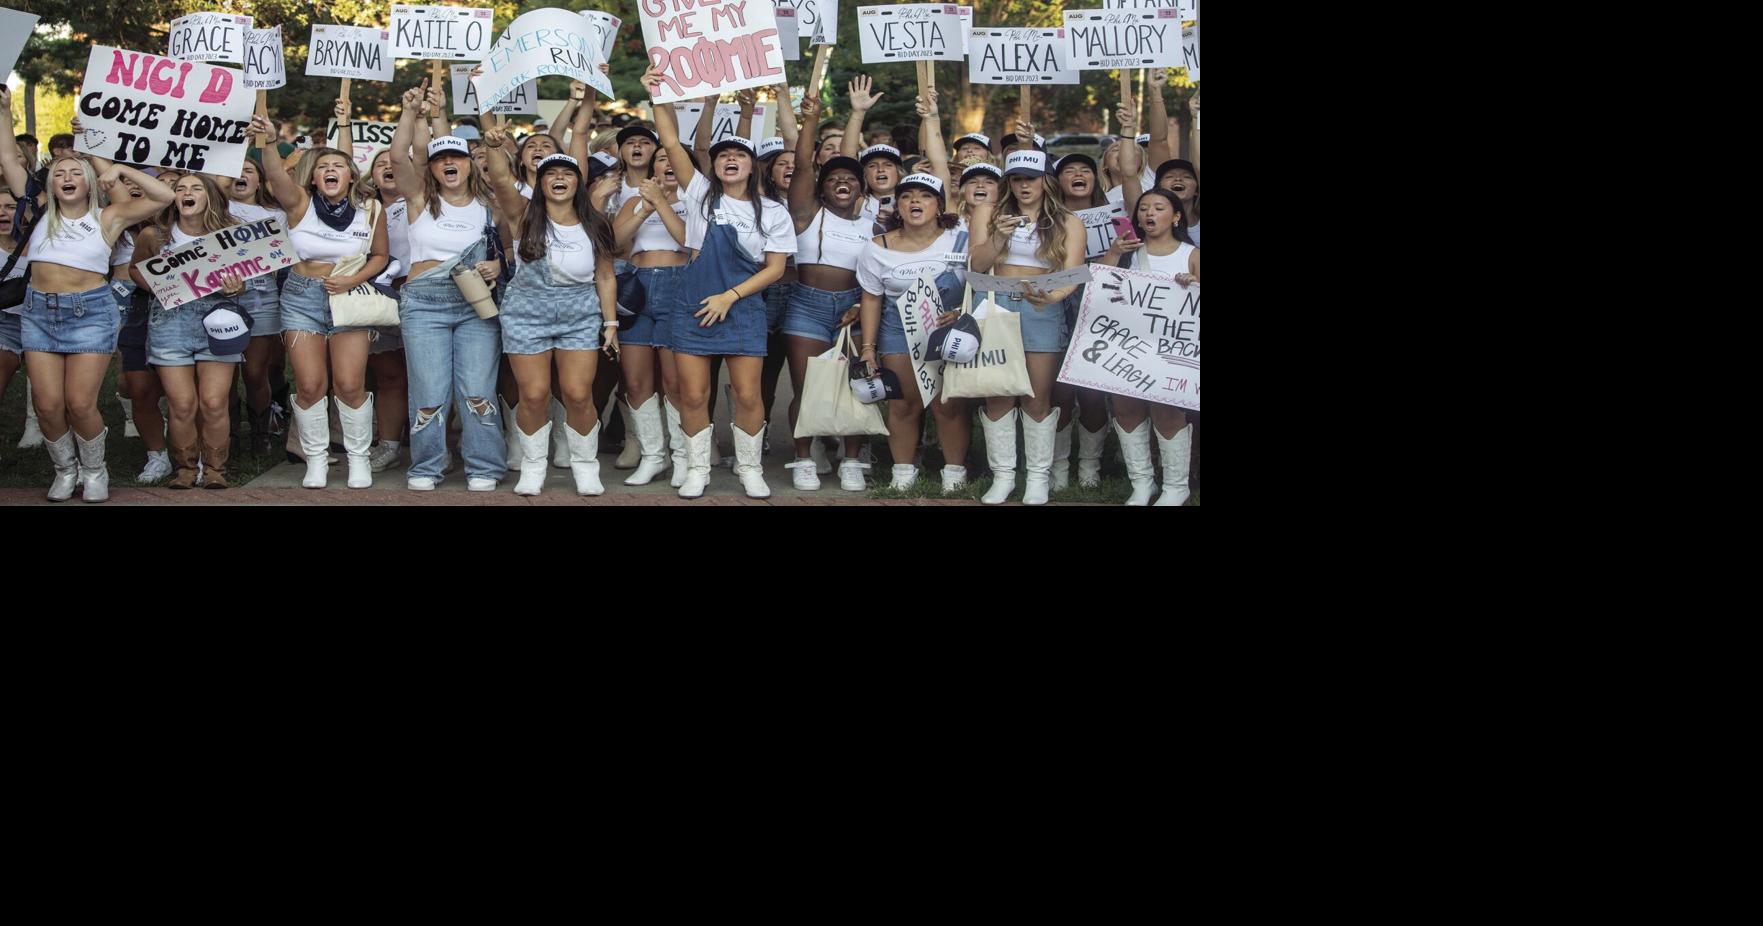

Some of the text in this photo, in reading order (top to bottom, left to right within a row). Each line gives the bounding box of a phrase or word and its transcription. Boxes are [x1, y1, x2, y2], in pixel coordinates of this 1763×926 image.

[396, 18, 459, 50] KATIE
[658, 1, 747, 42] ME MY
[869, 21, 946, 51] VESTA
[172, 26, 234, 56] GRACE
[314, 39, 382, 71] BRYNNA
[490, 28, 595, 72] EMERSON
[1071, 24, 1167, 58] MALLORY
[105, 50, 193, 99] NICI
[549, 47, 594, 76] RUN
[1111, 59, 1123, 67] DAY
[80, 92, 250, 144] COME HOME
[114, 131, 210, 171] TO ME
[432, 140, 445, 148] PHI
[761, 141, 774, 149] PHI
[1009, 156, 1039, 164] PHI MU
[921, 176, 936, 185] MU
[181, 255, 271, 299] Karinne
[1128, 279, 1171, 311] WE
[224, 325, 239, 333] MU
[918, 299, 936, 336] PHI
[904, 290, 937, 395] Built to last
[952, 337, 961, 351] PHI
[1082, 340, 1109, 364] &
[1090, 315, 1152, 360] GRACE
[981, 349, 1007, 367] MU
